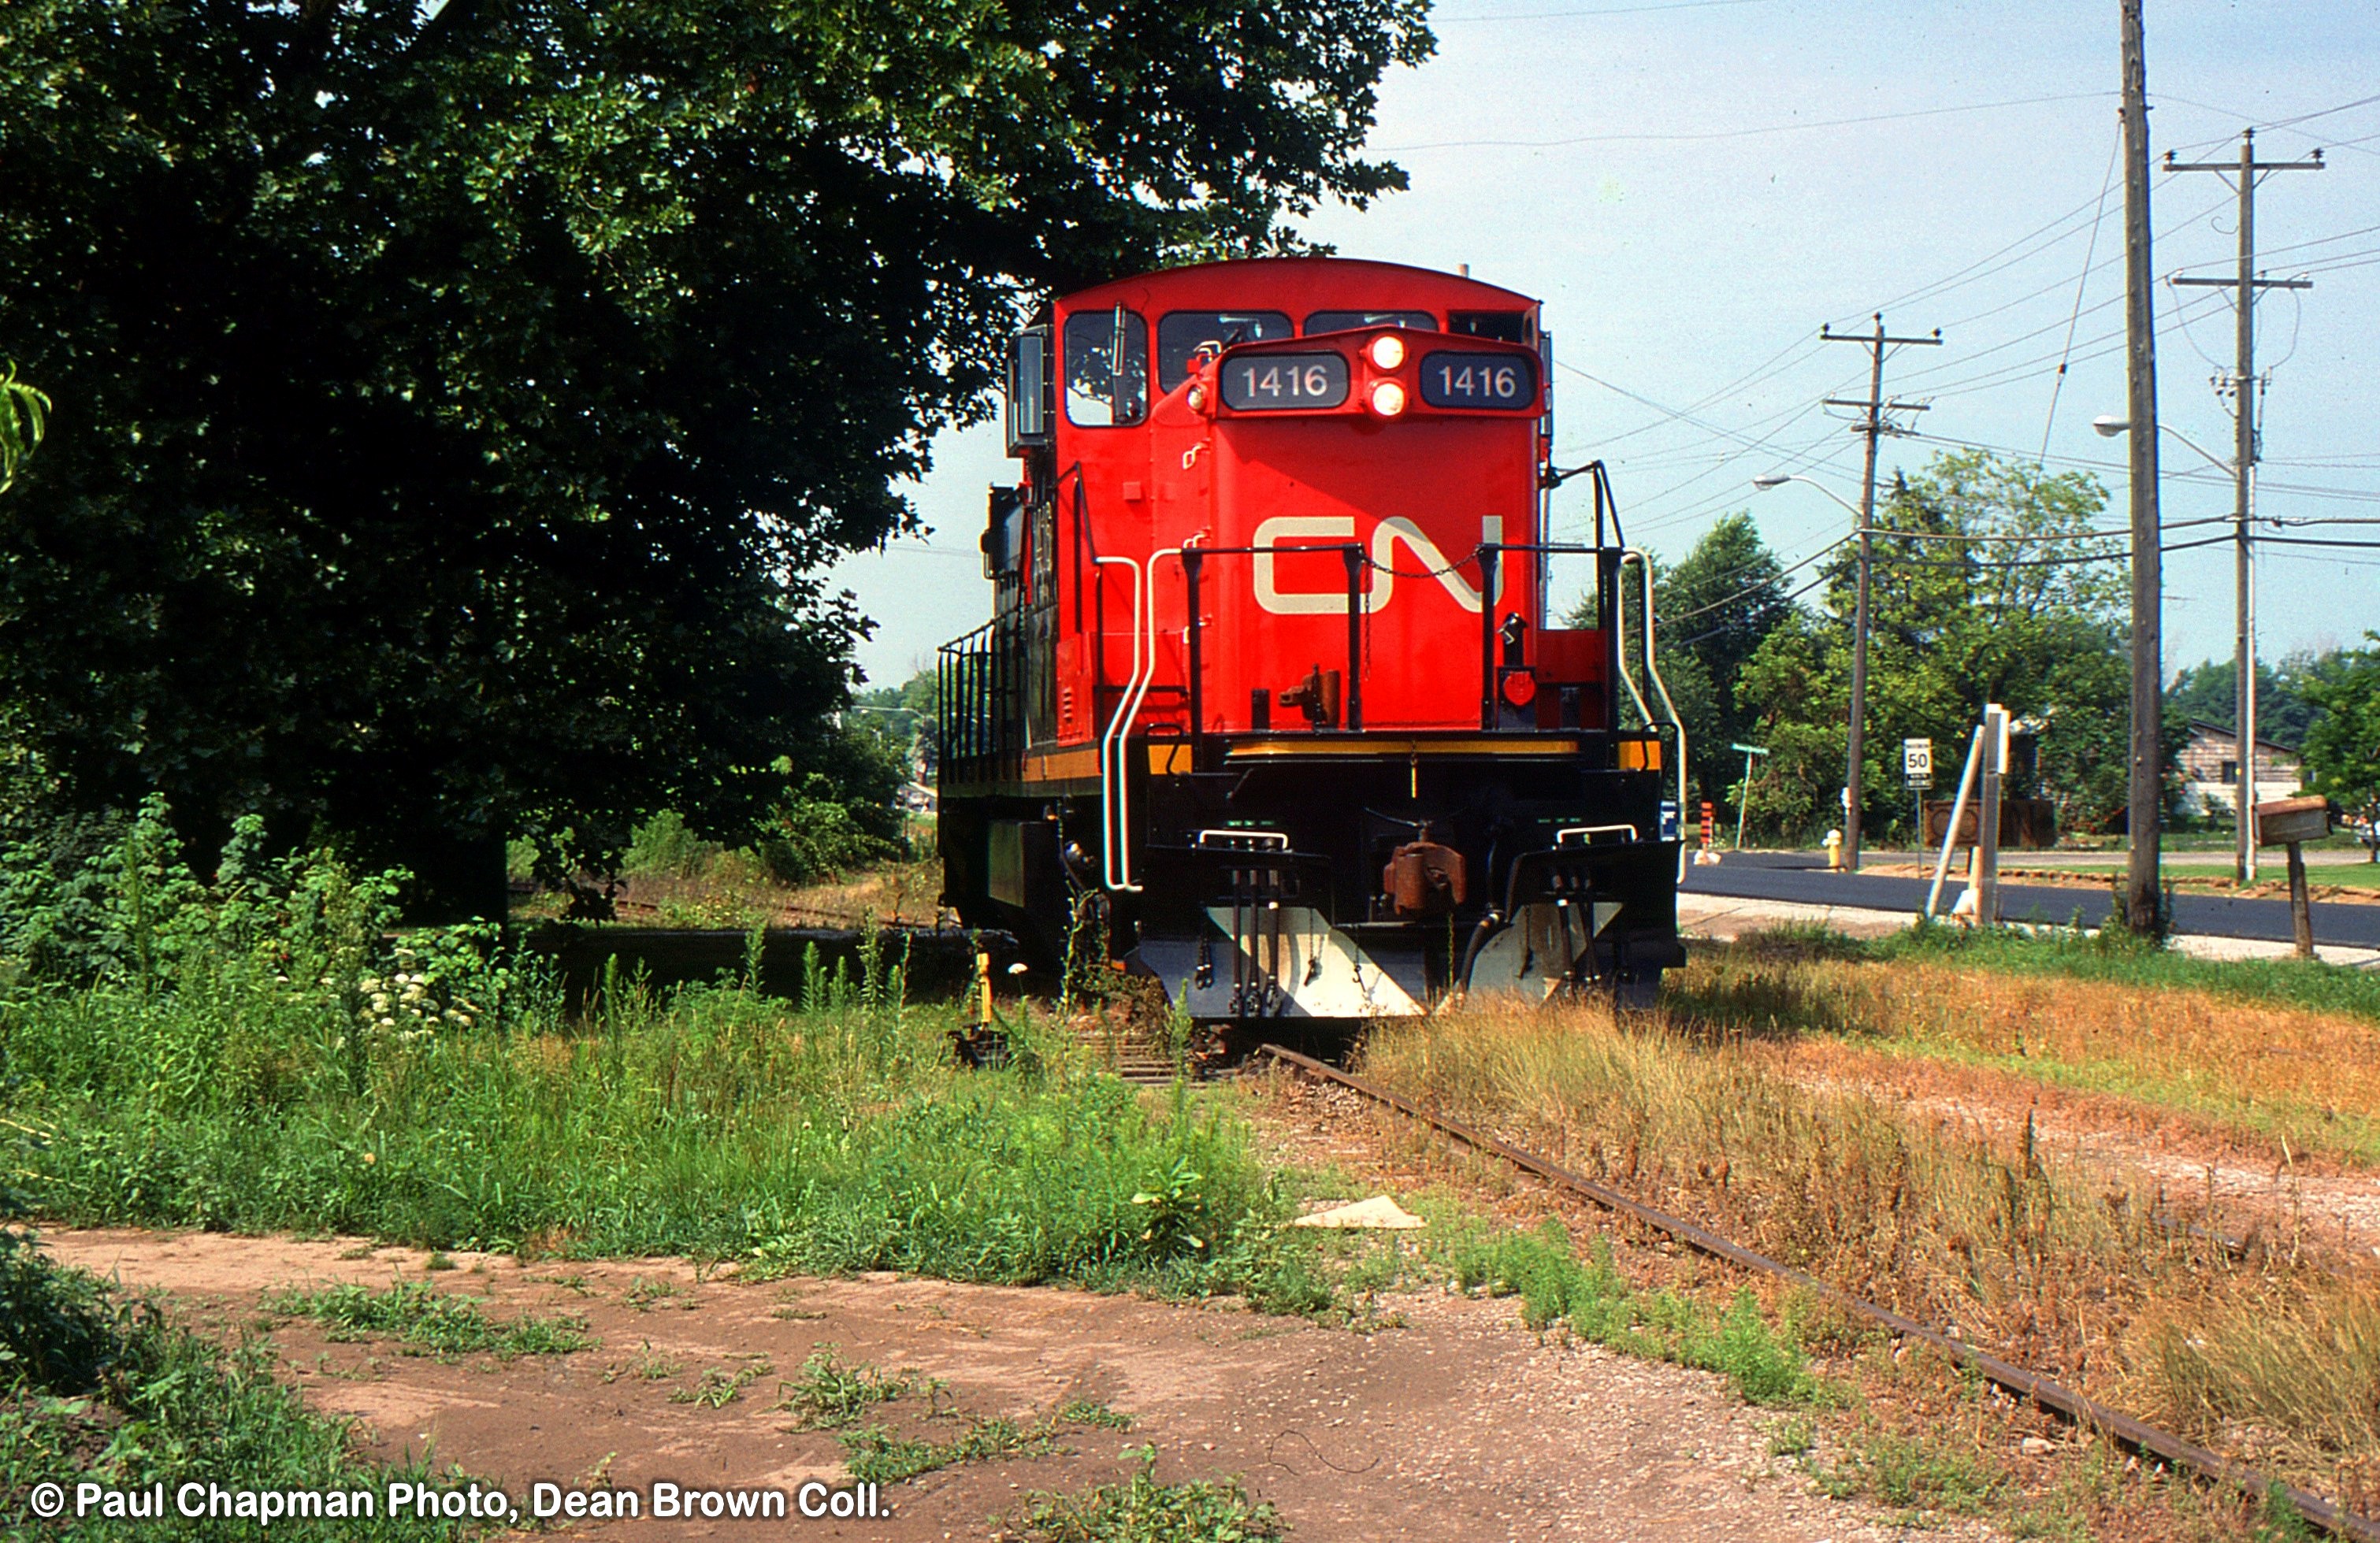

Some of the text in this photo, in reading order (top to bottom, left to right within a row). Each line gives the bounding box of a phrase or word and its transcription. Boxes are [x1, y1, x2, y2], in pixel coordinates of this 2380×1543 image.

[1242, 365, 1327, 396] 1416
[1438, 365, 1516, 397] 1416
[1253, 516, 1503, 614] CN
[1908, 753, 1928, 769] 50
